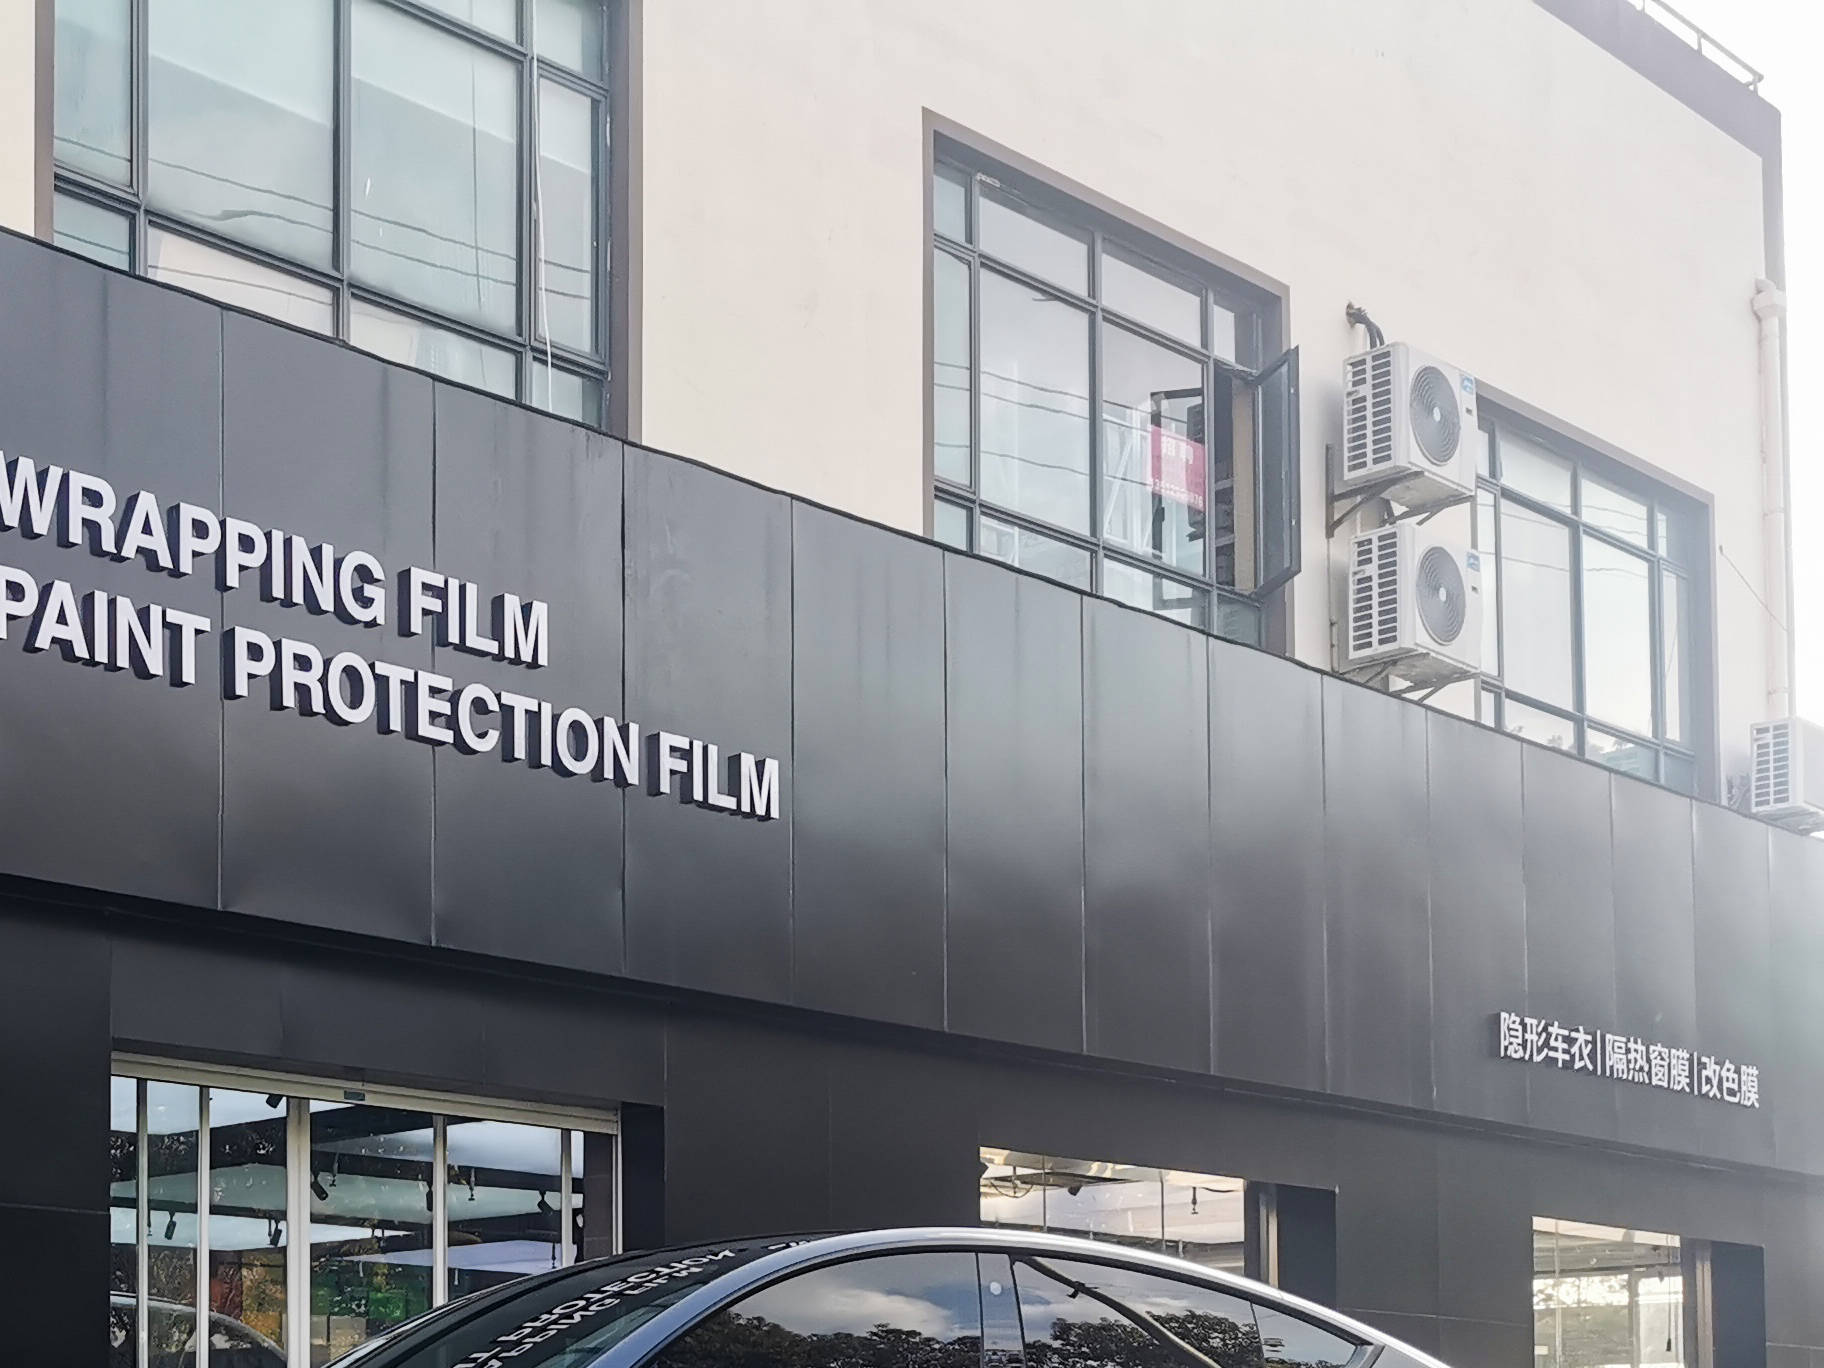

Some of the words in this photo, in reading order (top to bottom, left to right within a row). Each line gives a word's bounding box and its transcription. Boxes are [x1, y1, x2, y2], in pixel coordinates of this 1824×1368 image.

[400, 565, 549, 667] FILM
[225, 626, 640, 787] PROTECTION
[648, 731, 781, 820] FILM
[1499, 1011, 1594, 1072] 隐形车衣
[1605, 1033, 1692, 1094] 隔热窗膜
[1701, 1055, 1761, 1109] 改色膜
